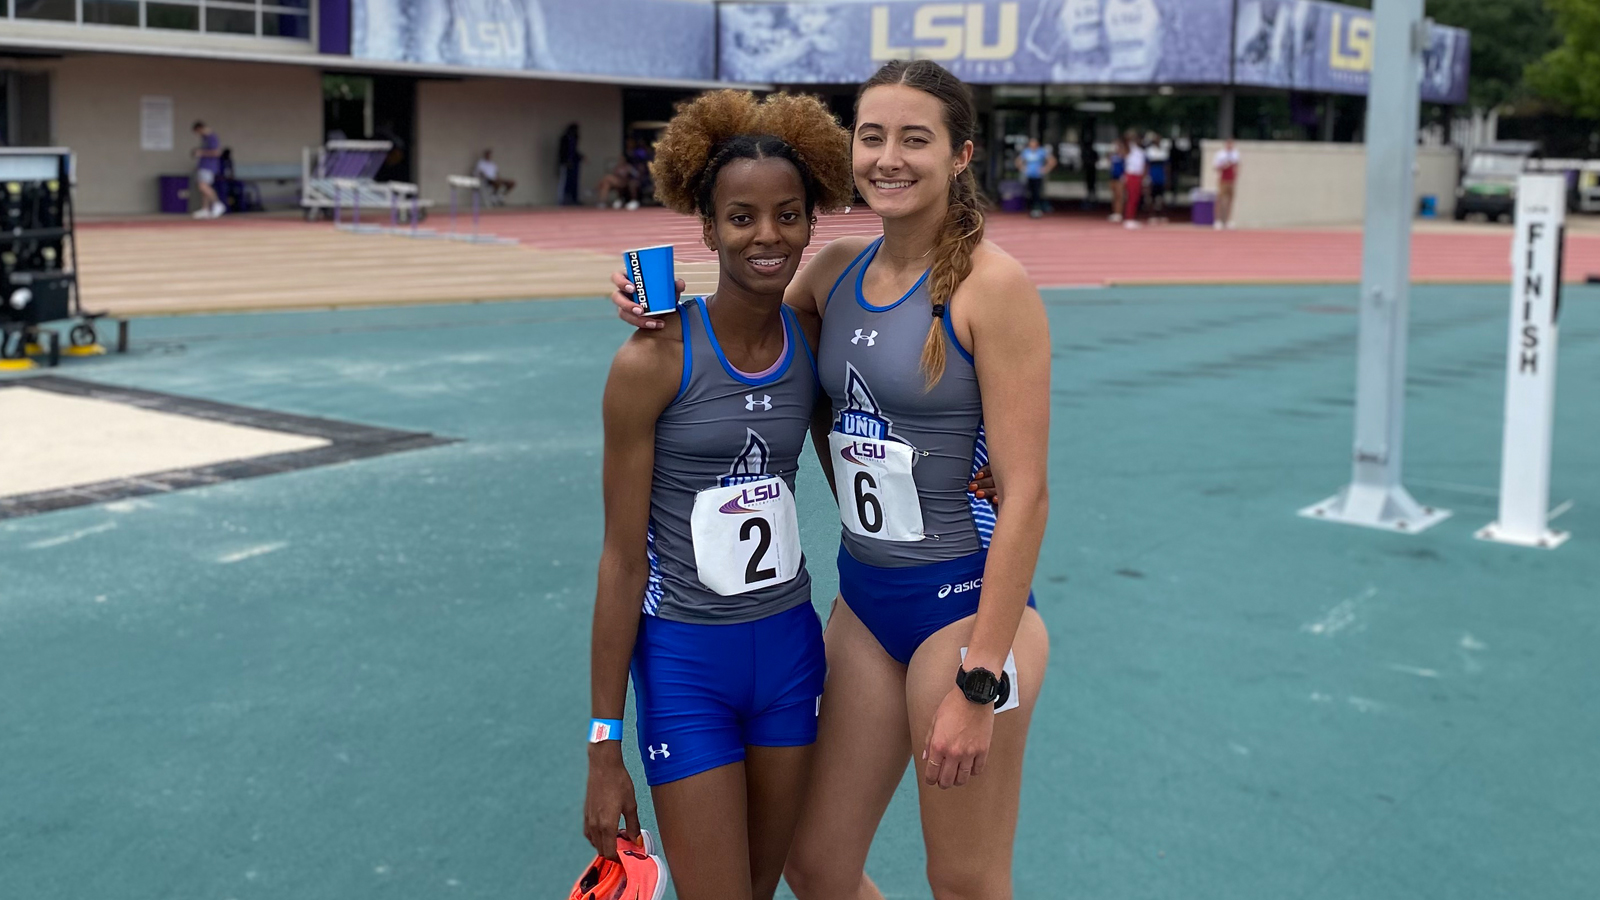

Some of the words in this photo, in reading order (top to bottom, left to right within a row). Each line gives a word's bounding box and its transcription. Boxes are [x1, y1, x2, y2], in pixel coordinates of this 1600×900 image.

[455, 17, 521, 56] LSU
[871, 2, 1018, 60] LSU
[1330, 11, 1374, 71] LS
[629, 252, 648, 309] POWERADE
[1519, 222, 1545, 374] FINISH
[843, 413, 881, 440] UNO
[853, 441, 886, 459] LSU
[741, 482, 781, 504] LSU
[854, 471, 883, 533] 6
[739, 517, 777, 585] 2
